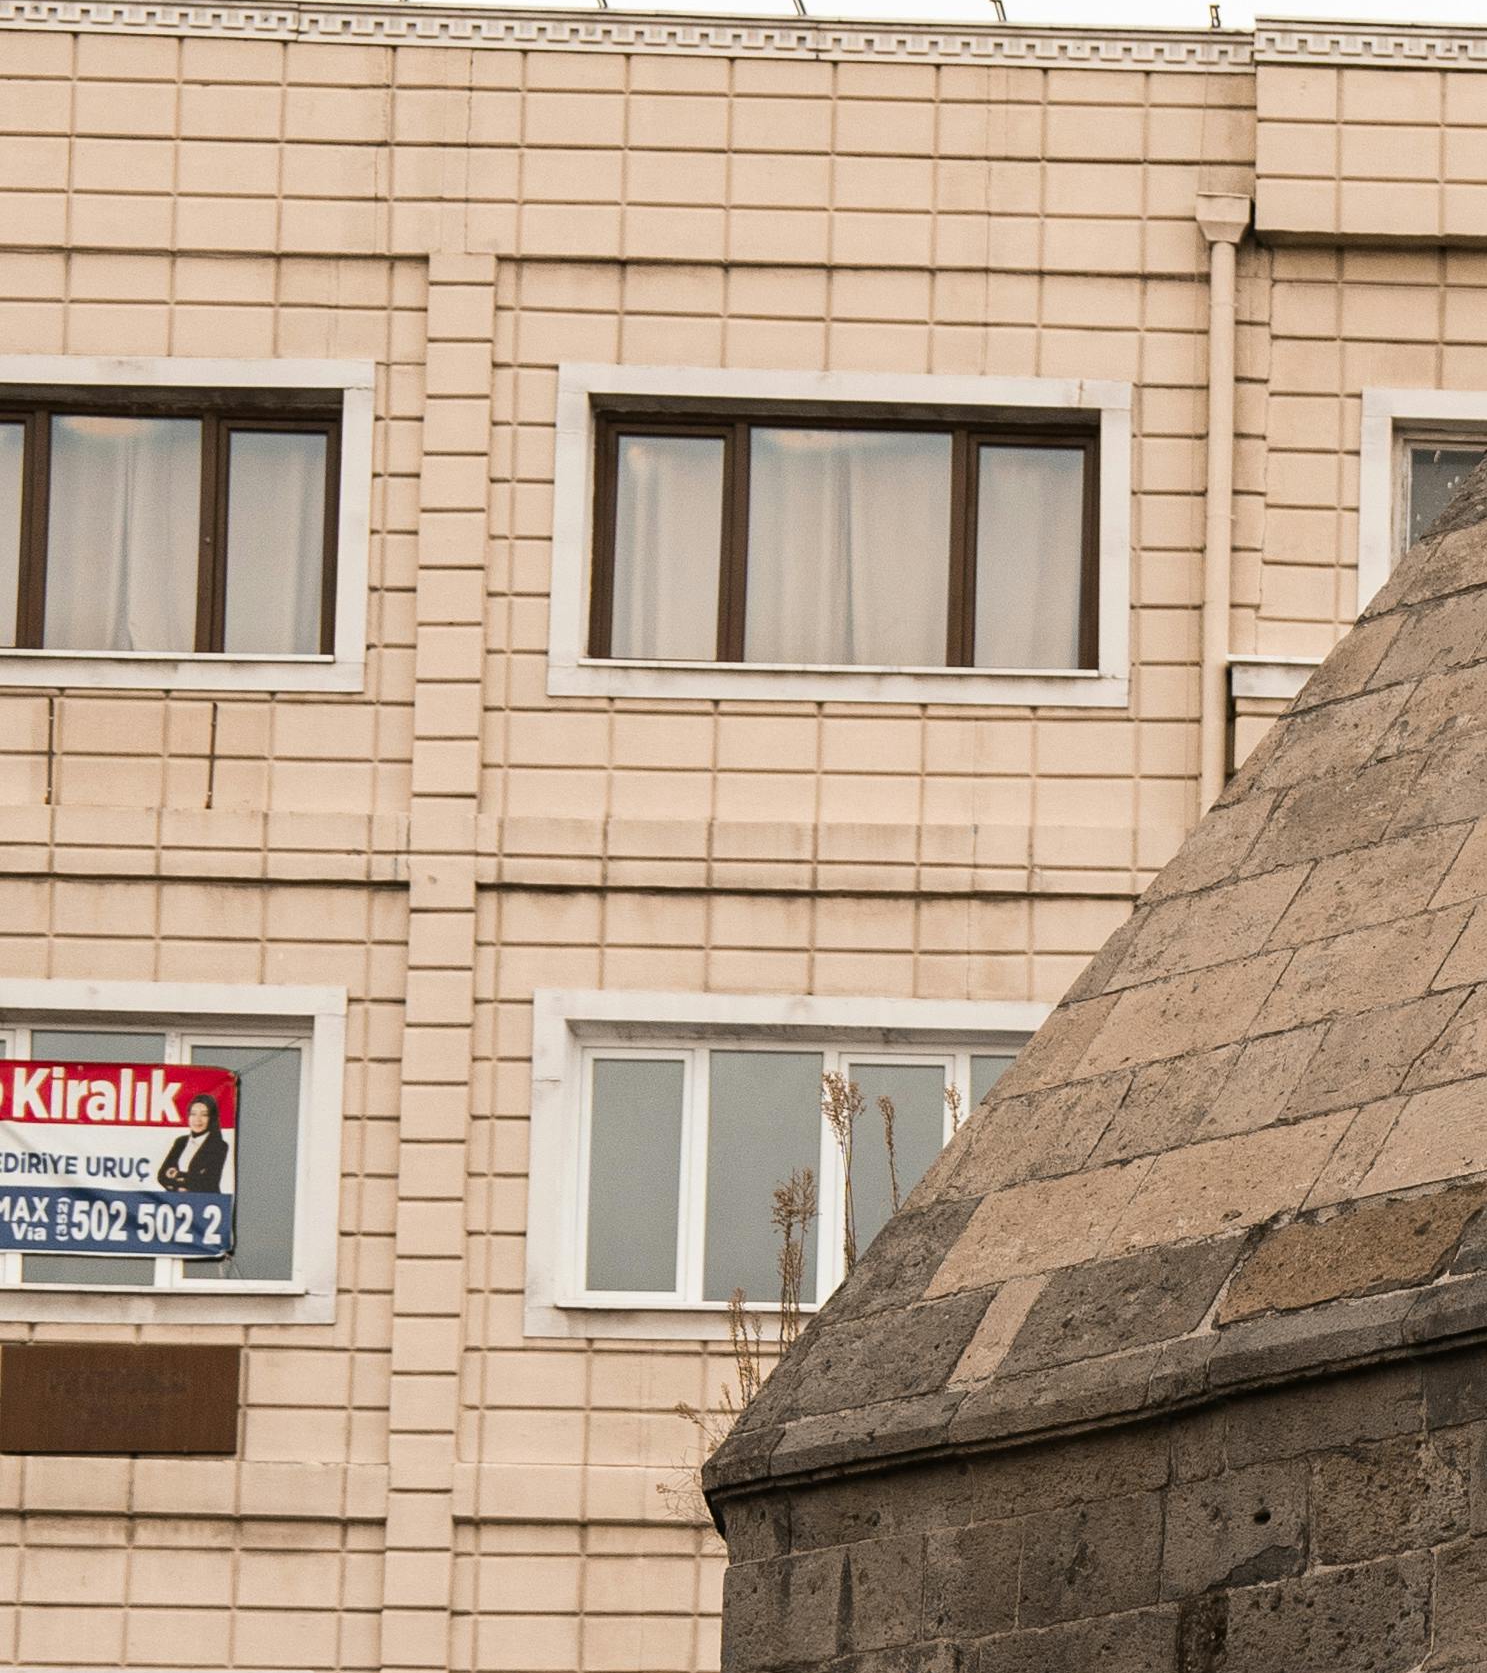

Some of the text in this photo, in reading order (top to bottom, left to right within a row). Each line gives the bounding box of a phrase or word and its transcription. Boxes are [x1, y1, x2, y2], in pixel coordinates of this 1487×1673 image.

[12, 1067, 182, 1123] Kiralık
[0, 1152, 150, 1182] DiRiYE URUÇ
[11, 1223, 47, 1241] Via
[71, 1200, 127, 1241] 502
[137, 1203, 193, 1243] 502
[202, 1205, 222, 1245] 2
